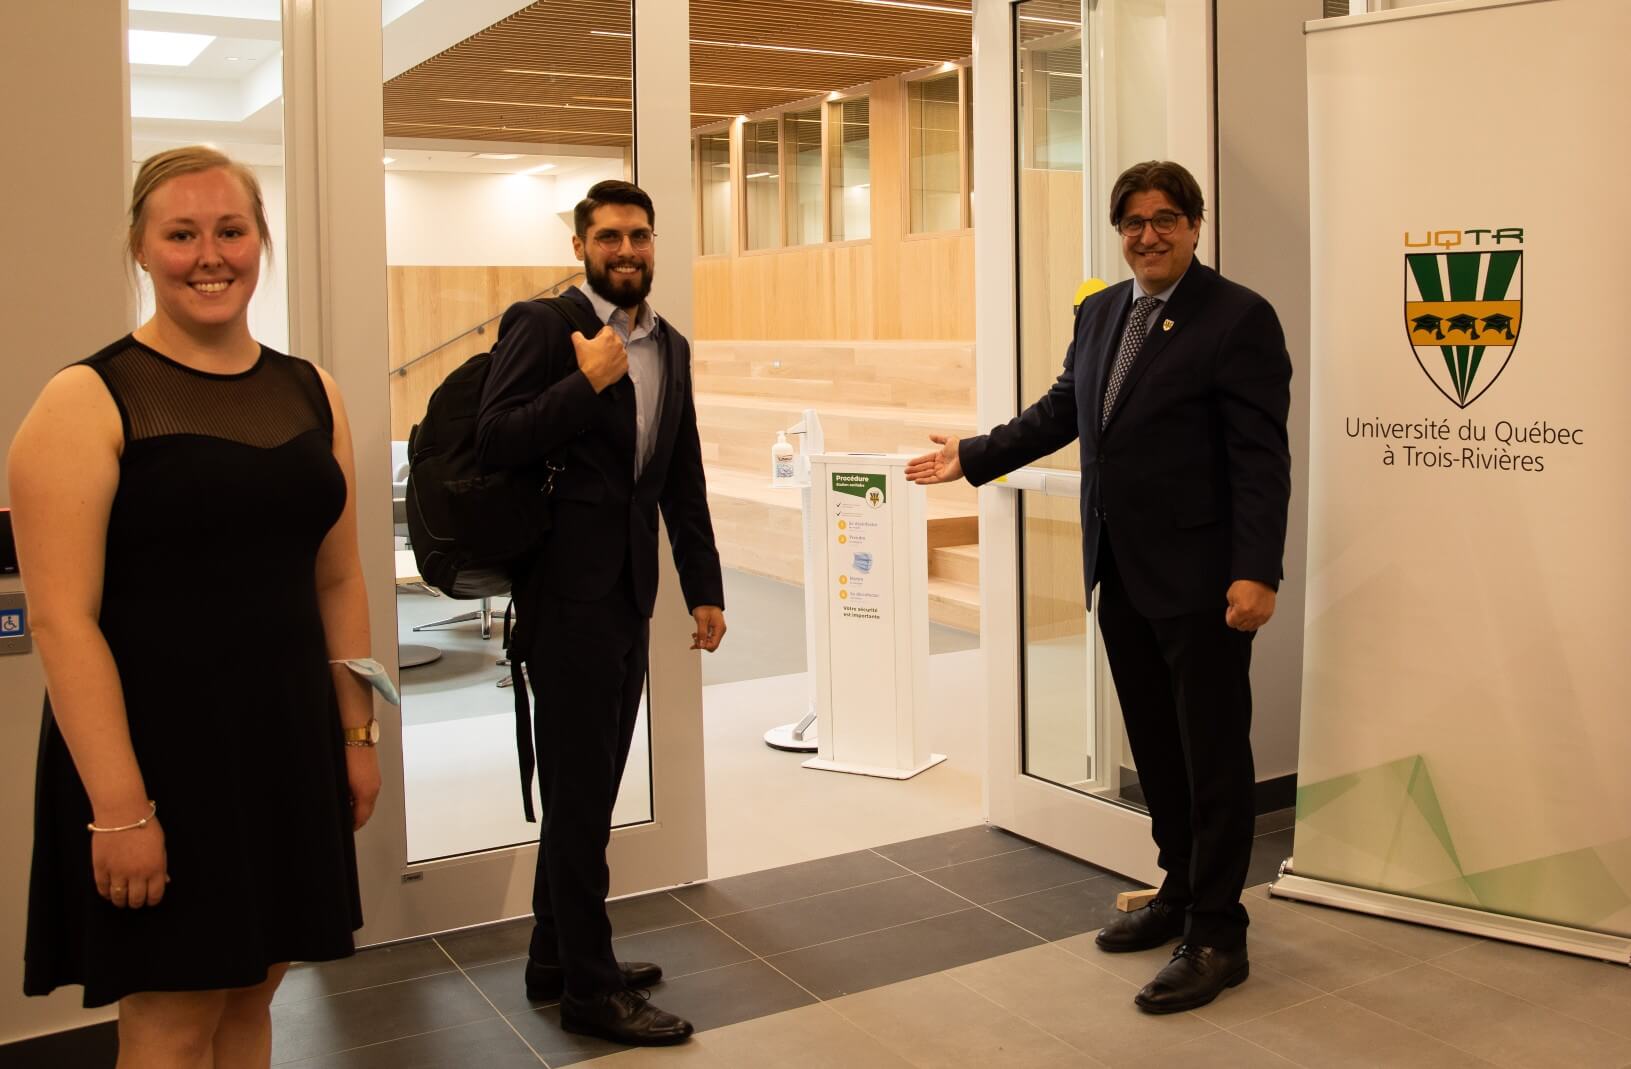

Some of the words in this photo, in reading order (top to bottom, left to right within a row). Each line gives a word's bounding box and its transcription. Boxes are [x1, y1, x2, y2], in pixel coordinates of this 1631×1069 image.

[1404, 228, 1524, 250] UQTR
[1346, 417, 1450, 440] Université
[1458, 419, 1486, 442] du
[1495, 420, 1584, 446] Québec
[1383, 444, 1395, 466] à
[1403, 446, 1545, 472] Trois-Rivières
[835, 475, 869, 483] Procédure
